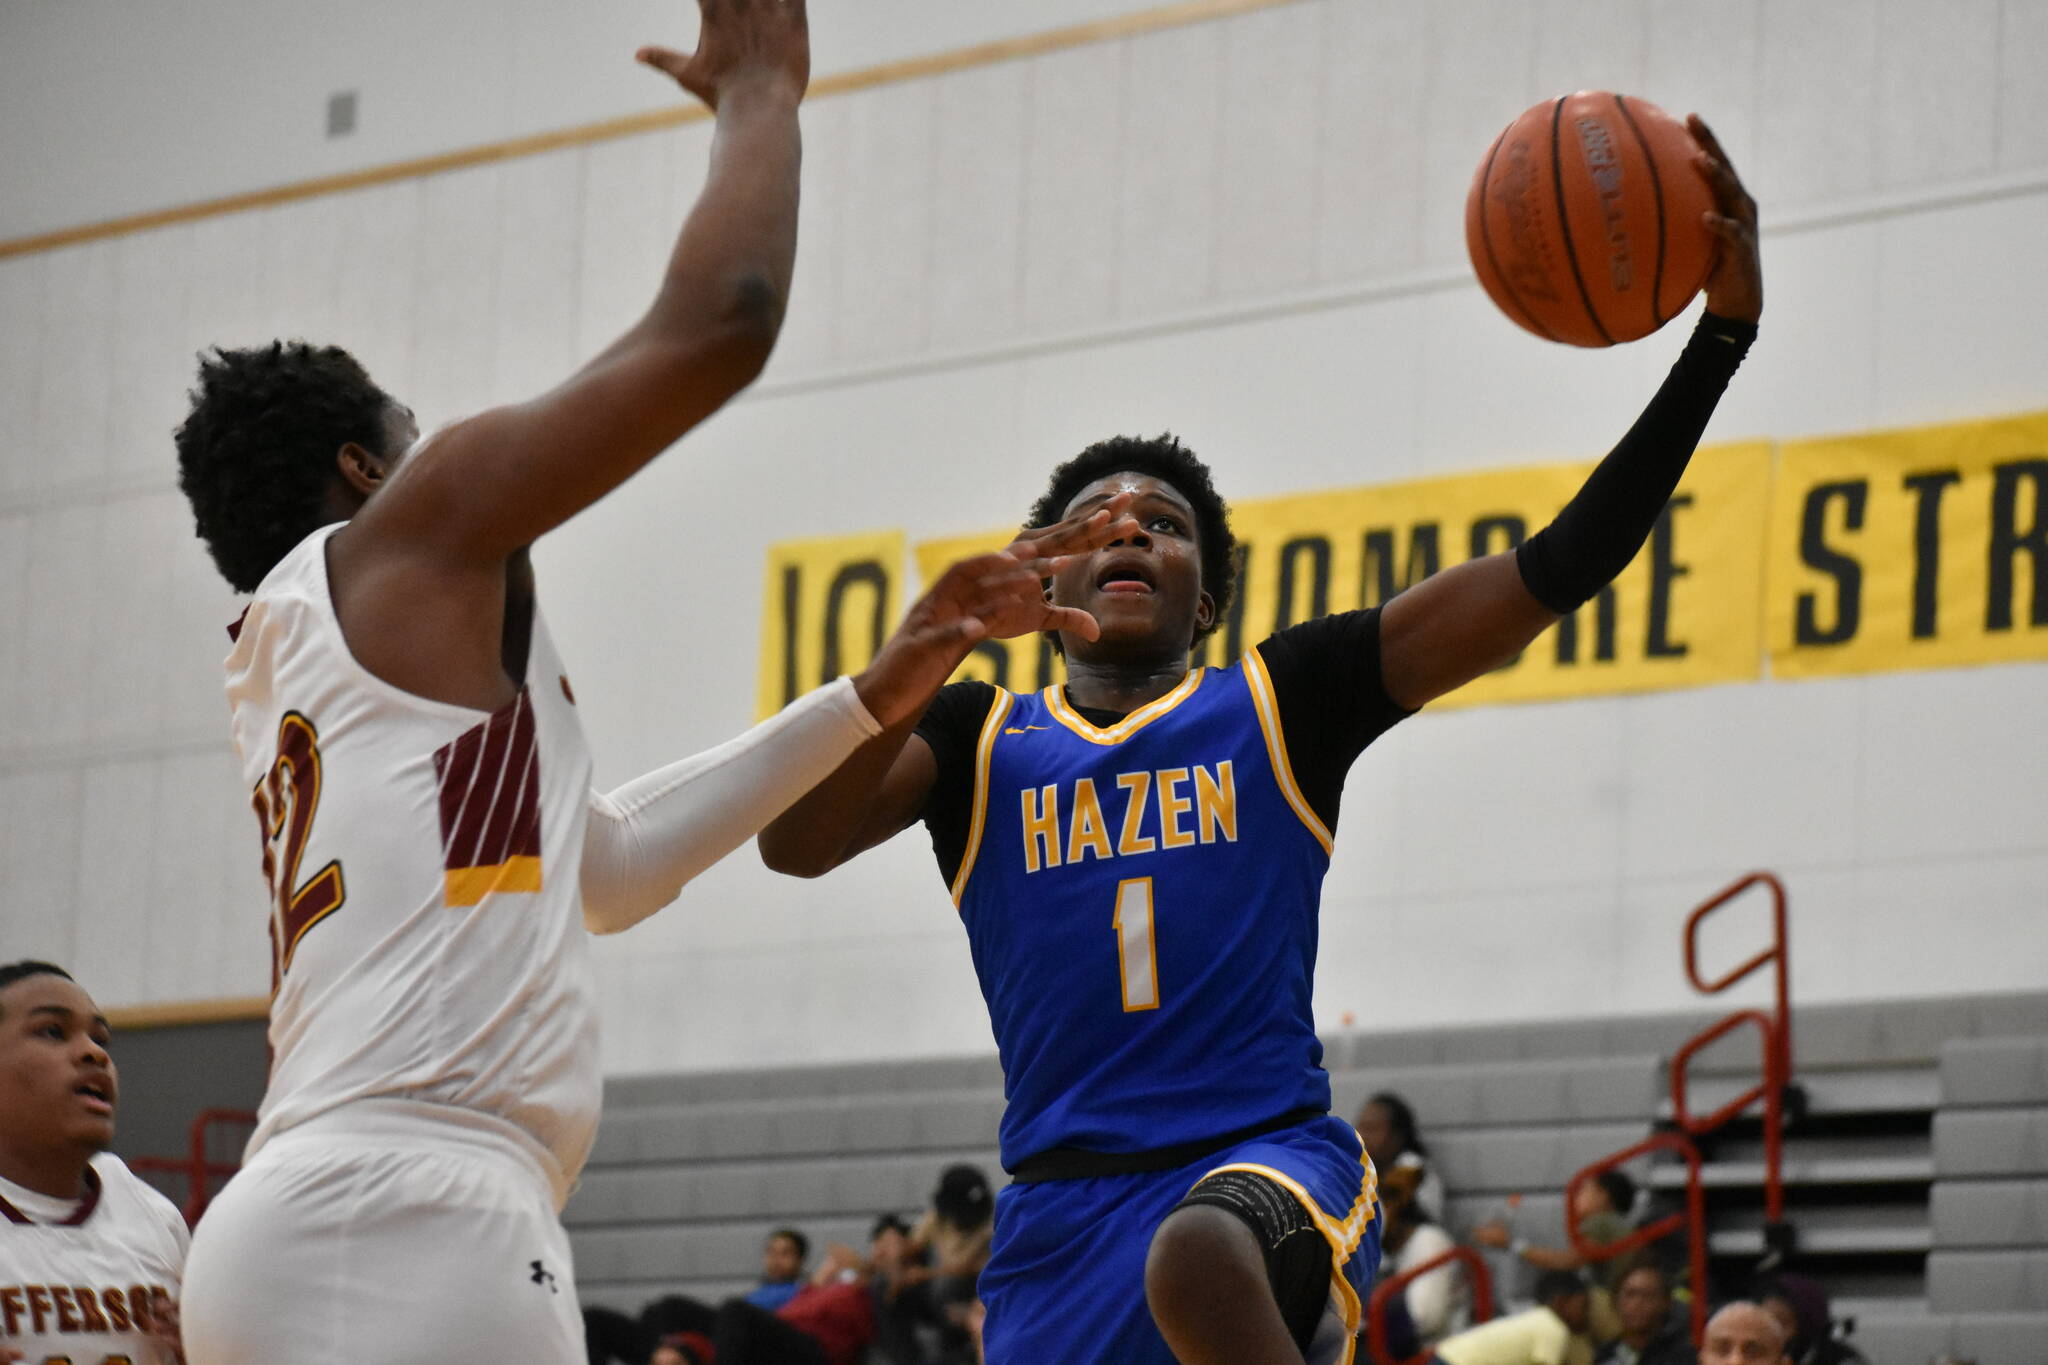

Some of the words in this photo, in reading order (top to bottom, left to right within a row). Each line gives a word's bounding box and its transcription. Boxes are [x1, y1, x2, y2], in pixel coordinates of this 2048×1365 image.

[252, 710, 346, 1000] 2
[1021, 760, 1237, 873] HAZEN
[1112, 876, 1159, 1012] 1
